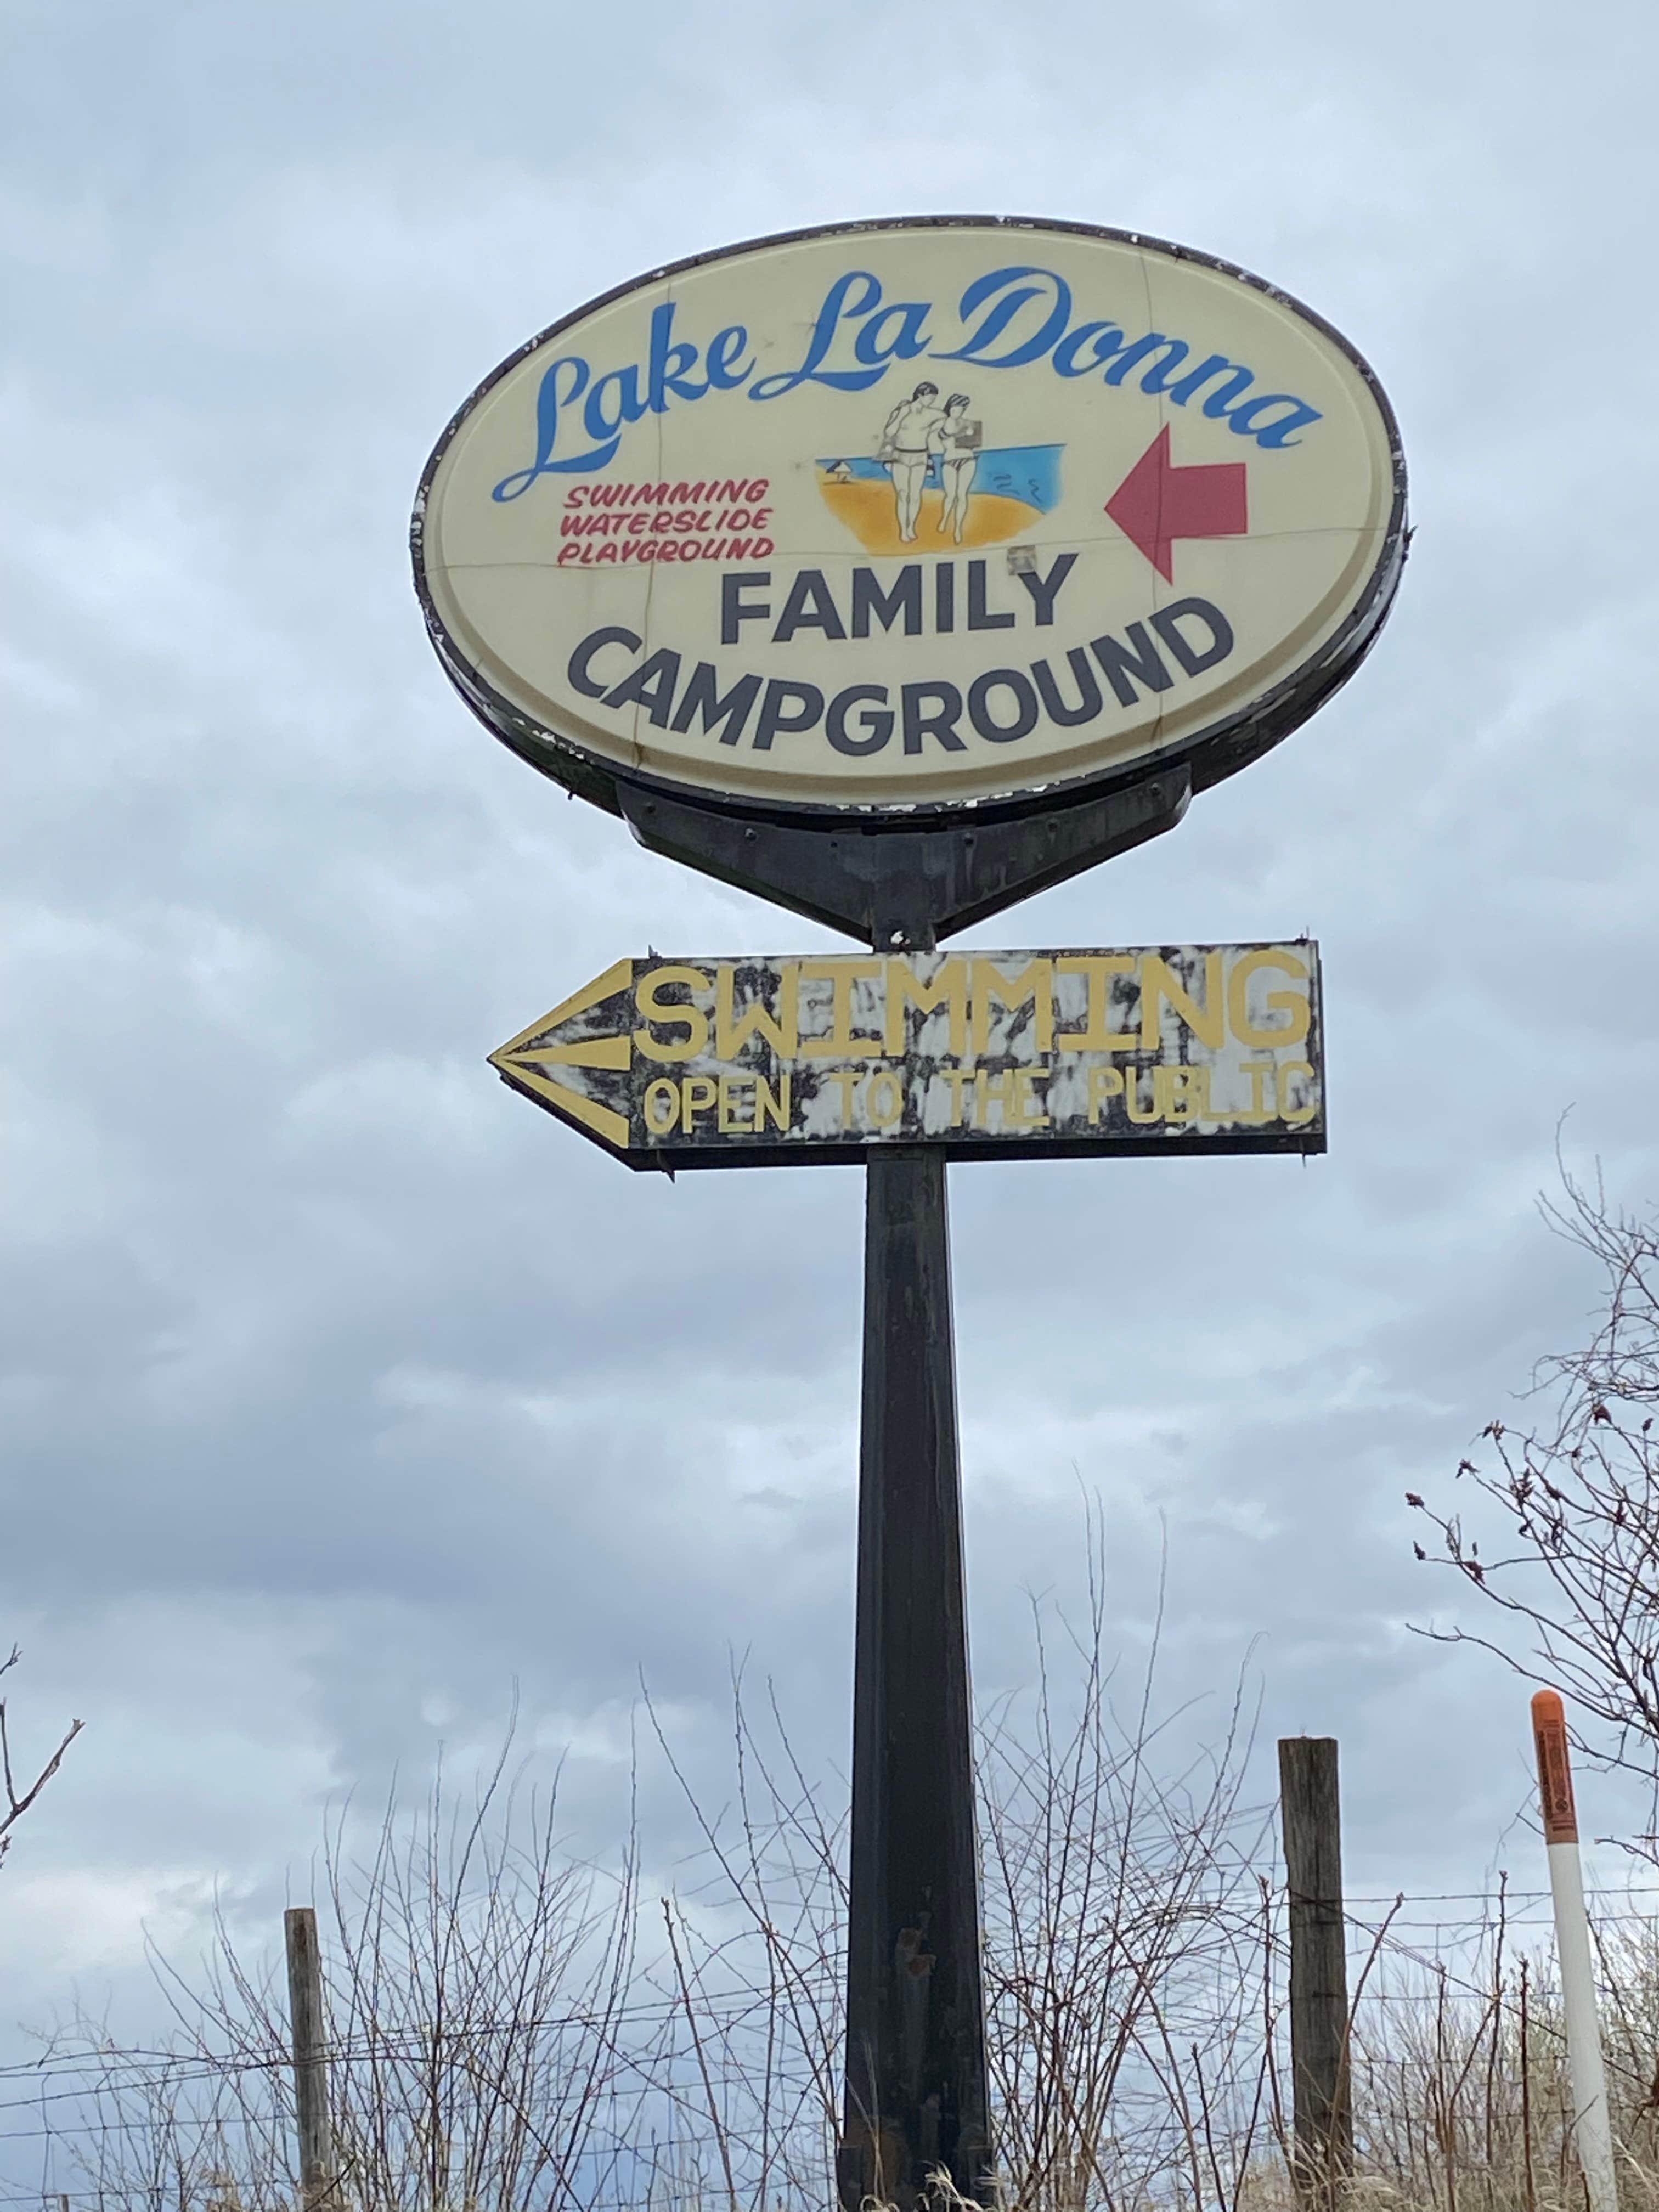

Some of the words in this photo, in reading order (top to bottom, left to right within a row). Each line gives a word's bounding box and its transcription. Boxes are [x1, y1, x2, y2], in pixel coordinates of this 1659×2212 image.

[492, 302, 757, 503] Lake
[560, 508, 774, 537] WATERSLIDE
[563, 479, 770, 509] SWIMMING
[557, 538, 775, 566] PLAYGROUND
[721, 553, 1079, 645] FAMILY
[567, 597, 1234, 756] CAMPGROUND
[633, 950, 1310, 1063] SWIMMING
[644, 1074, 791, 1134] OPEN
[831, 1071, 903, 1130] TO
[940, 1067, 1050, 1127] THE
[1088, 1060, 1315, 1125] PUBLIC
